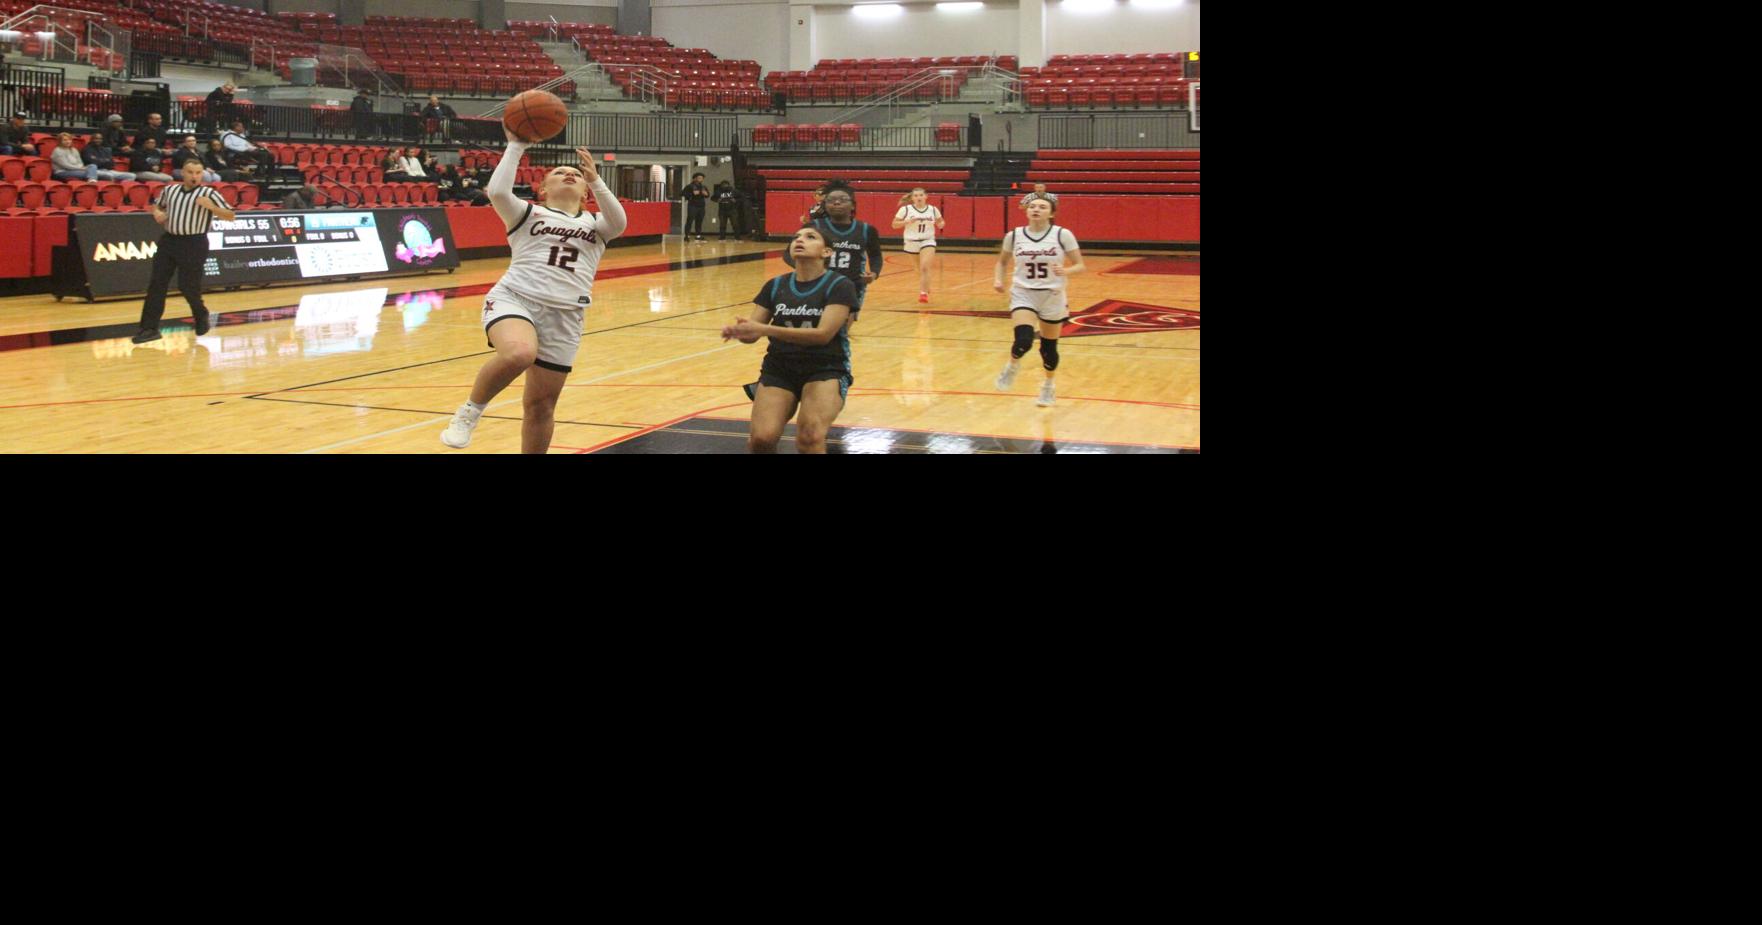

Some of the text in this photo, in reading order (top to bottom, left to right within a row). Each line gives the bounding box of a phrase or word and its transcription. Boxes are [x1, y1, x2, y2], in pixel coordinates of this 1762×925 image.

[257, 219, 270, 230] 55
[530, 221, 596, 244] Cowgirls
[918, 224, 926, 233] 11
[833, 240, 861, 250] nthers
[547, 246, 579, 273] 12
[829, 251, 851, 268] 12
[1025, 262, 1048, 279] 35
